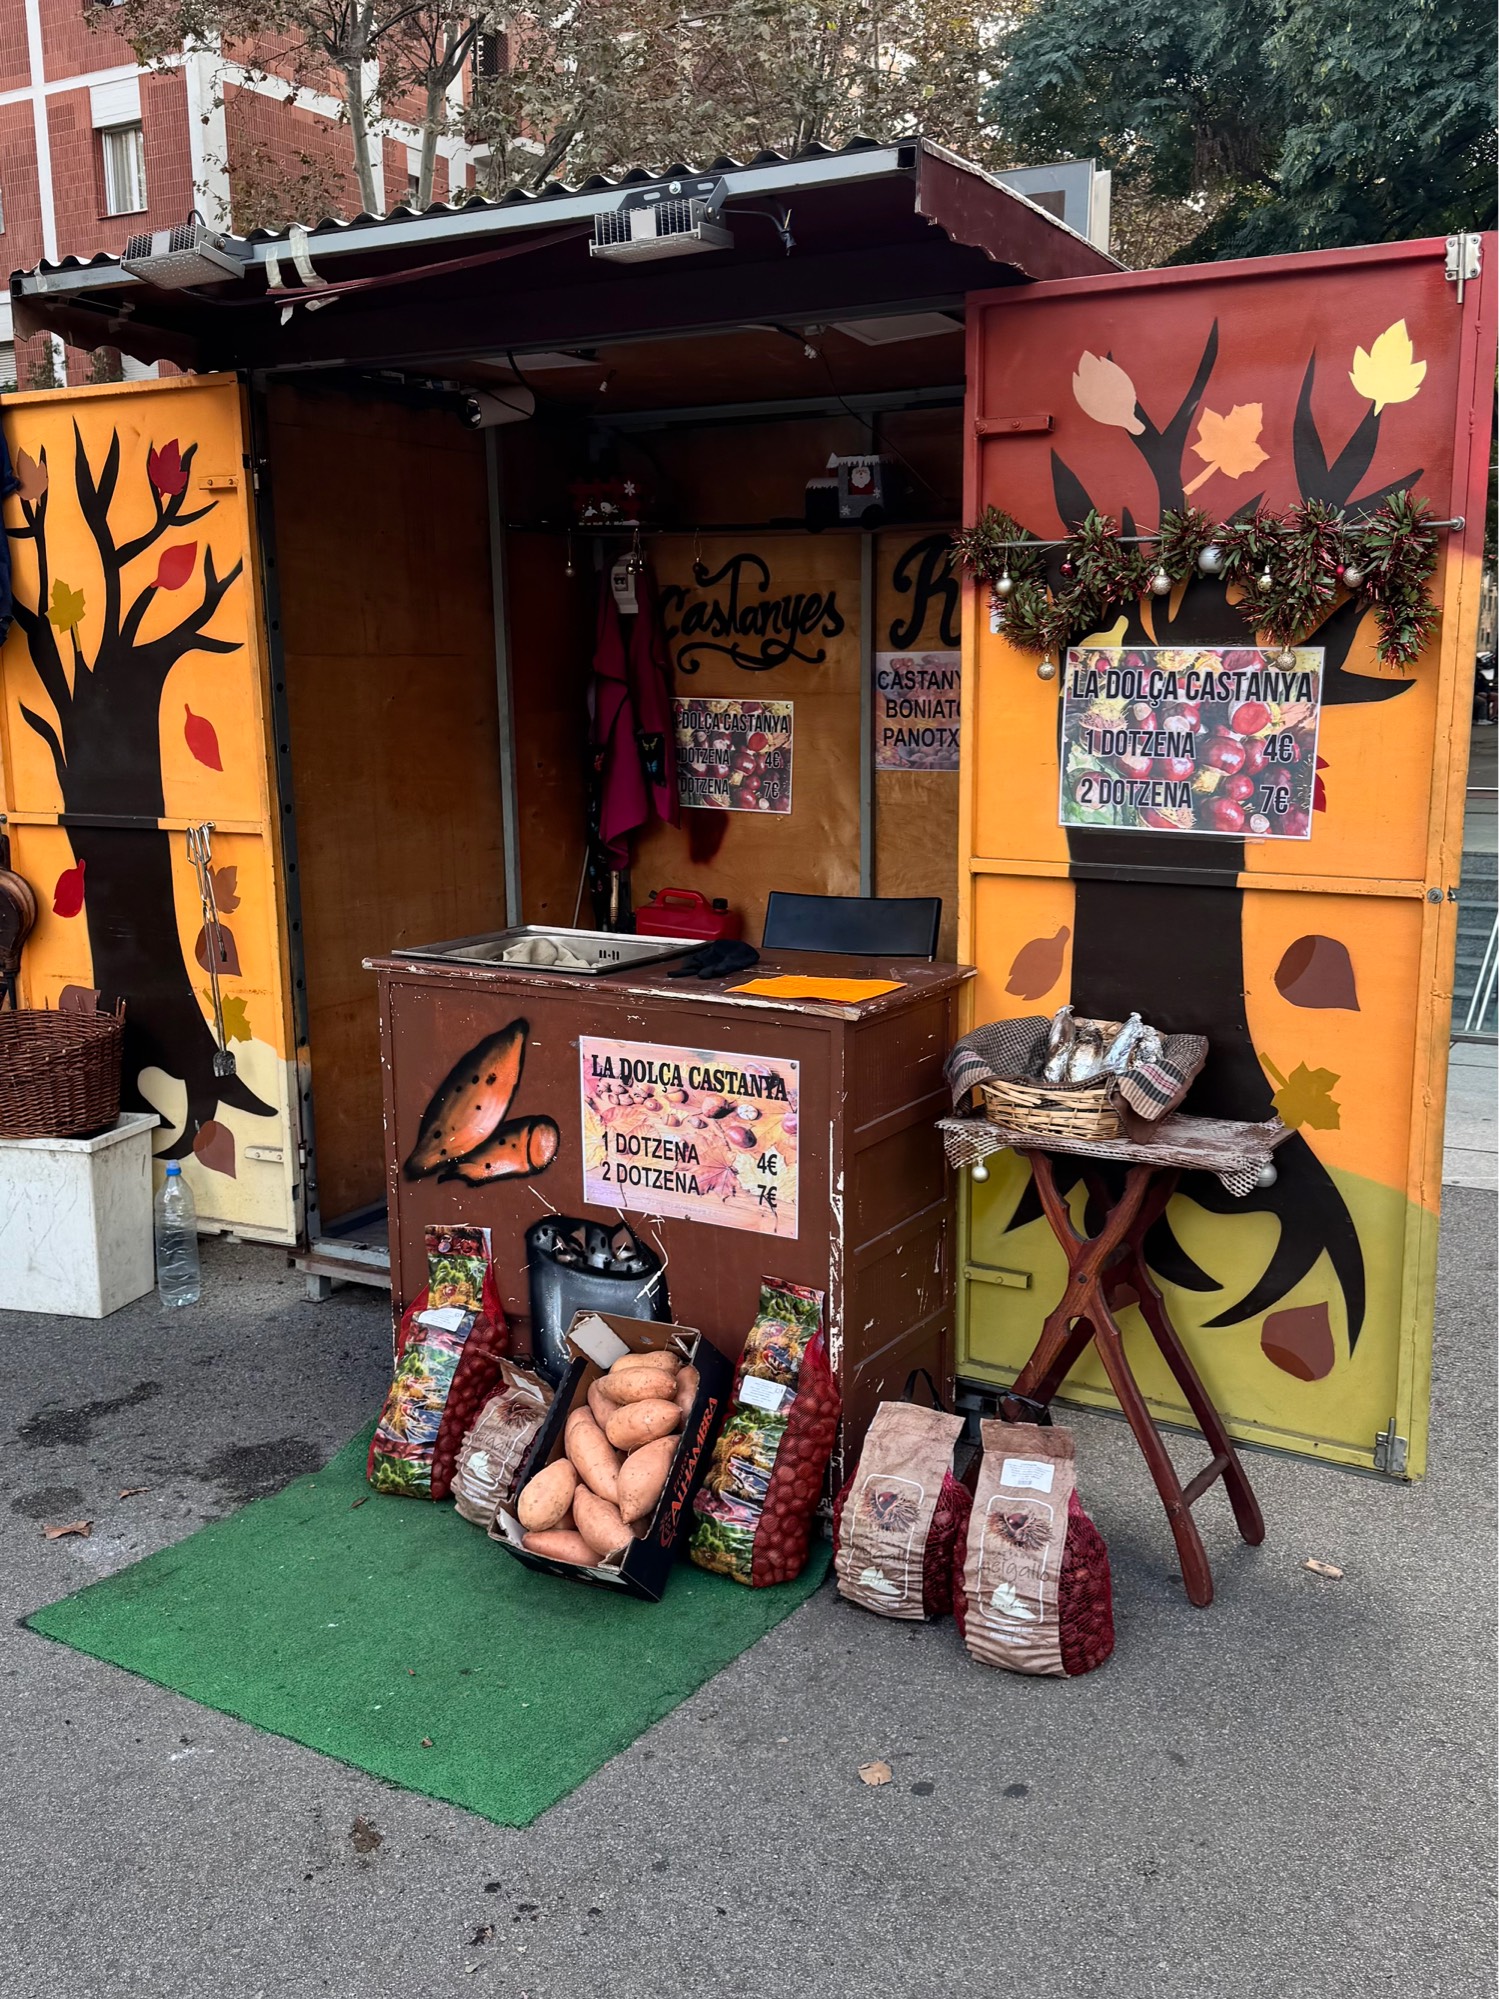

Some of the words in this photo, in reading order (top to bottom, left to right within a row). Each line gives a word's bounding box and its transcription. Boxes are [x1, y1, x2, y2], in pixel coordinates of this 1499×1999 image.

[661, 553, 845, 674] Castanyes
[1072, 670, 1099, 699] LA
[1106, 671, 1178, 706] DOLÇA
[1186, 671, 1312, 703] CASTANYA
[682, 711, 720, 734] DOLÇA
[724, 713, 789, 733] CASTANYA
[886, 699, 961, 718] BONIAT
[680, 748, 730, 765] DOTZENA
[765, 752, 781, 768] 4€
[1085, 731, 1093, 755] 1
[1101, 730, 1195, 759] DOTZENA
[1262, 734, 1293, 763] 4€
[681, 777, 729, 795] DOTZENA
[764, 781, 780, 798] 7€
[1080, 778, 1092, 804] 2
[1098, 779, 1192, 808] DOTZENA
[1260, 786, 1290, 814] 7€
[591, 1054, 615, 1079] LA
[619, 1058, 684, 1092] DOLÇA
[689, 1066, 788, 1101] CASTANYA
[601, 1131, 609, 1151] 1
[616, 1133, 700, 1165] DOTZENA
[757, 1153, 778, 1175] 4€
[602, 1161, 611, 1181] 2
[617, 1163, 700, 1195] DOTZENA
[757, 1185, 778, 1207] 7€
[671, 1398, 718, 1528] ALHAMBRA
